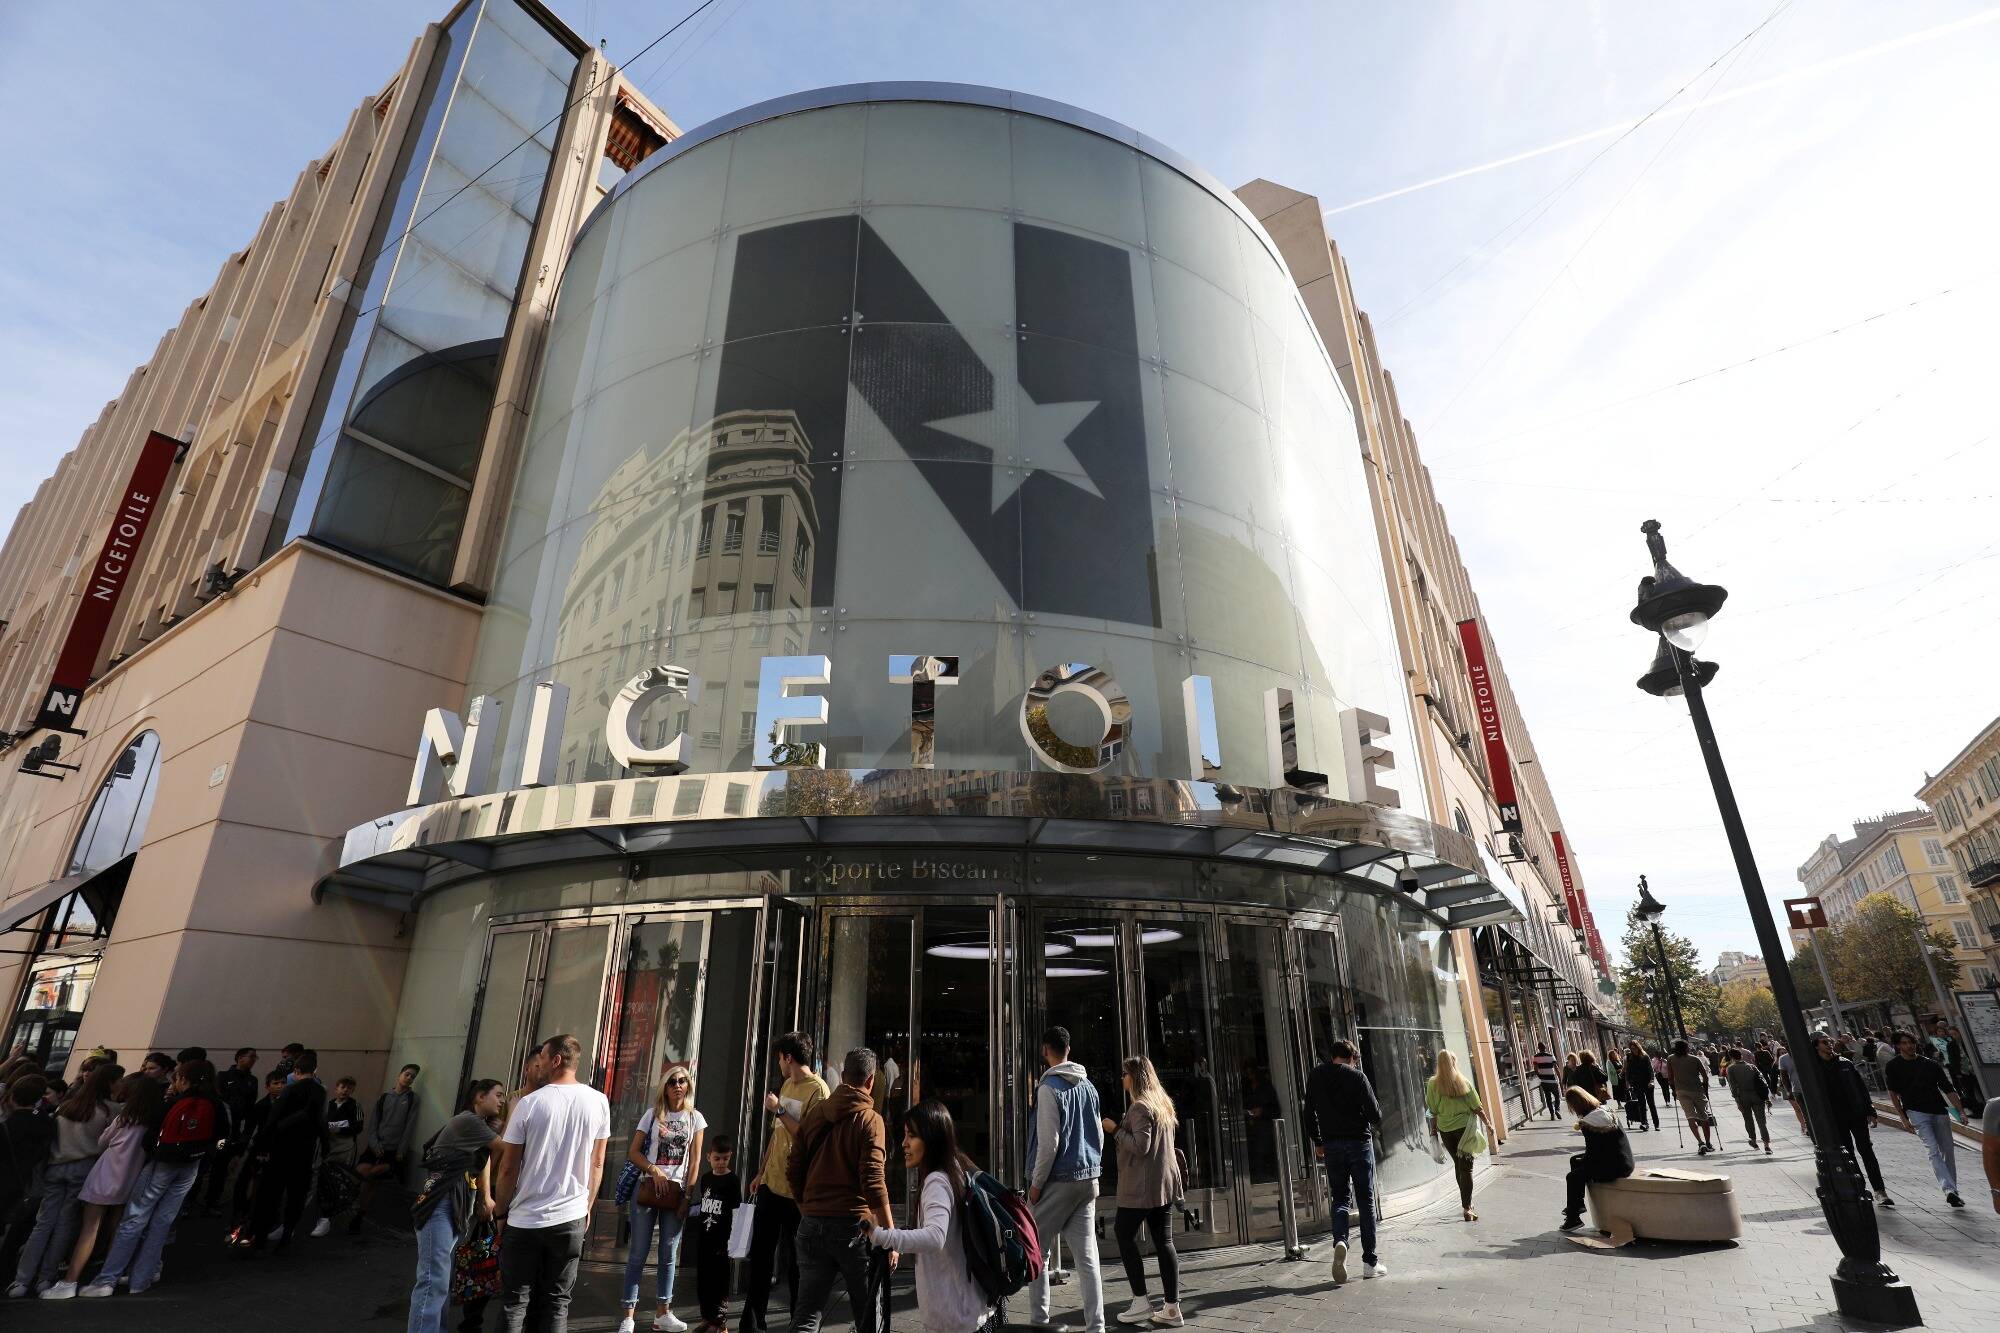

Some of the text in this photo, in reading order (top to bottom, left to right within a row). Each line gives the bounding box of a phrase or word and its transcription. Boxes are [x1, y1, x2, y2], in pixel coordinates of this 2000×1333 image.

[93, 491, 150, 601] NICETOILE
[47, 690, 77, 715] N
[1473, 665, 1500, 742] NICETOILE
[406, 655, 1401, 807] NICETOILE
[1502, 805, 1518, 822] N
[831, 861, 901, 885] porte
[1559, 855, 1574, 897] NICETOILE
